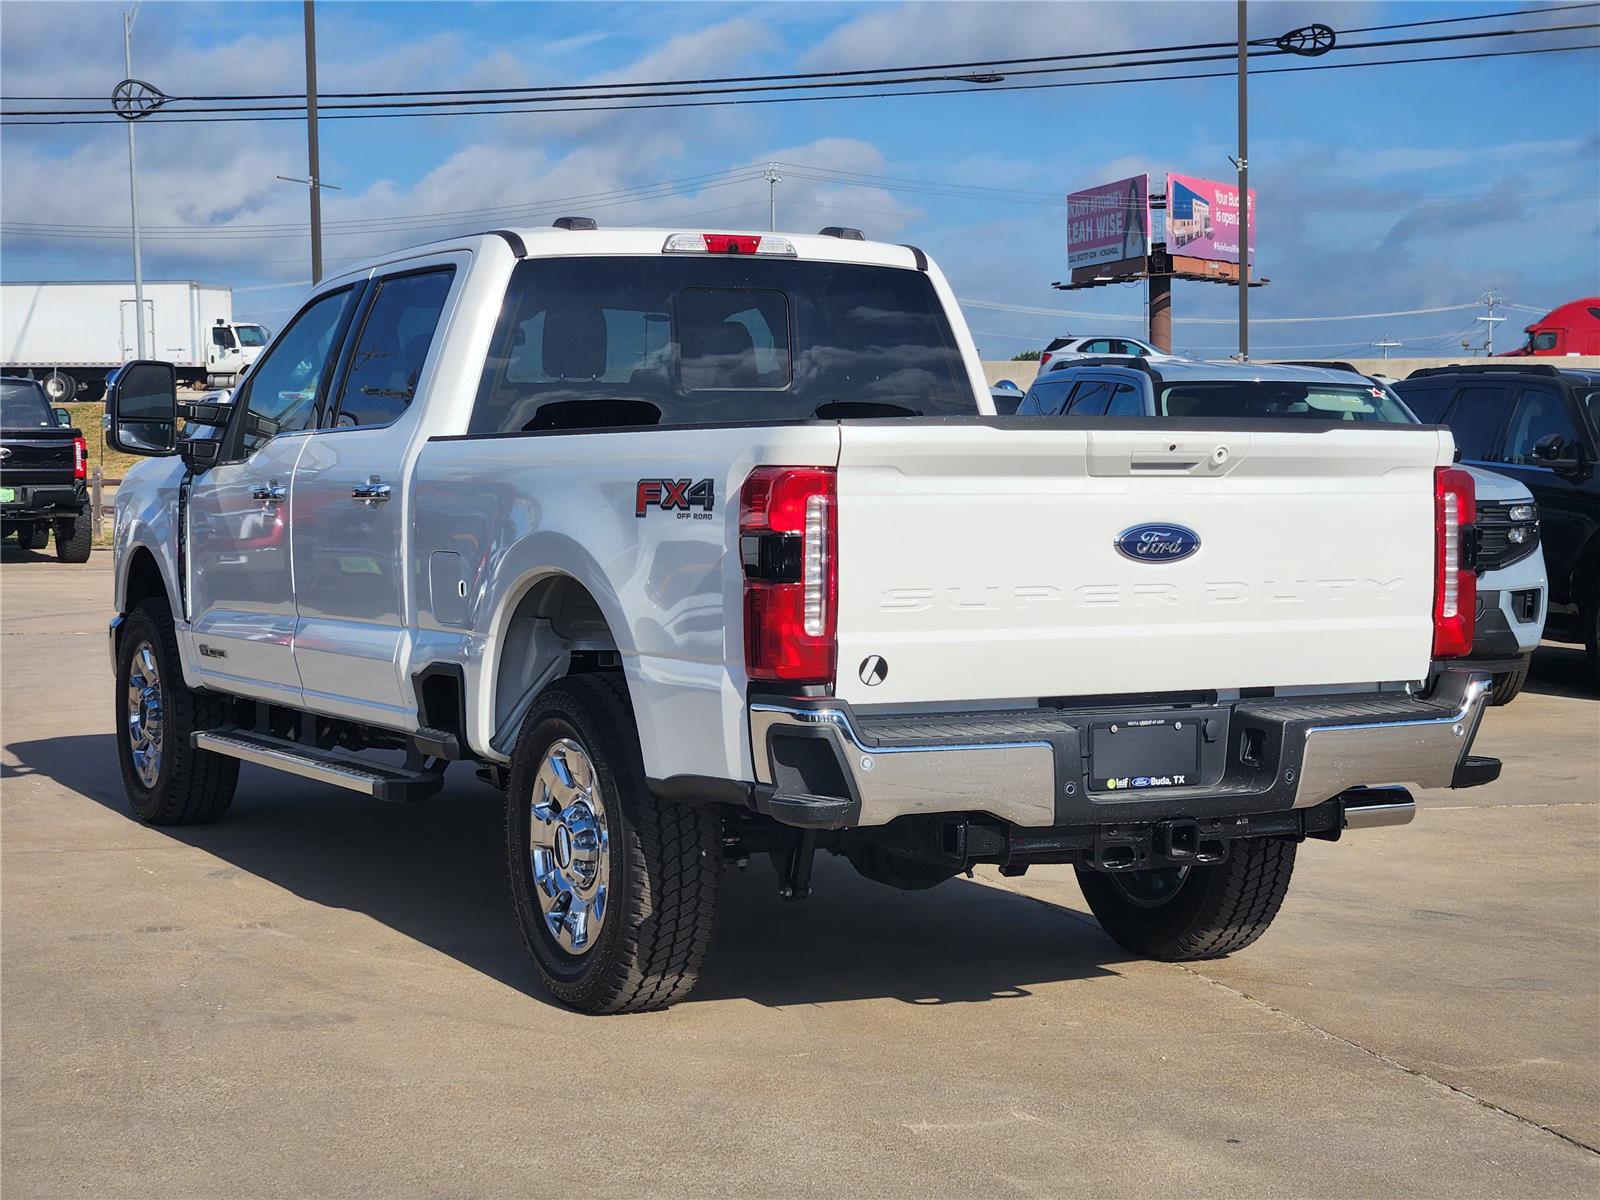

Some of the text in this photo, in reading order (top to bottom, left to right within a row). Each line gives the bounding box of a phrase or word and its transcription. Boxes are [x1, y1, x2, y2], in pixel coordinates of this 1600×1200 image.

[1215, 189, 1228, 205] Your
[1068, 212, 1122, 244] LEAH WISE
[1216, 207, 1221, 223] is
[1222, 212, 1236, 227] open
[636, 478, 715, 518] FX4
[1136, 531, 1183, 555] Ford
[880, 577, 1403, 612] SUPER DUTY
[1173, 775, 1185, 784] TX
